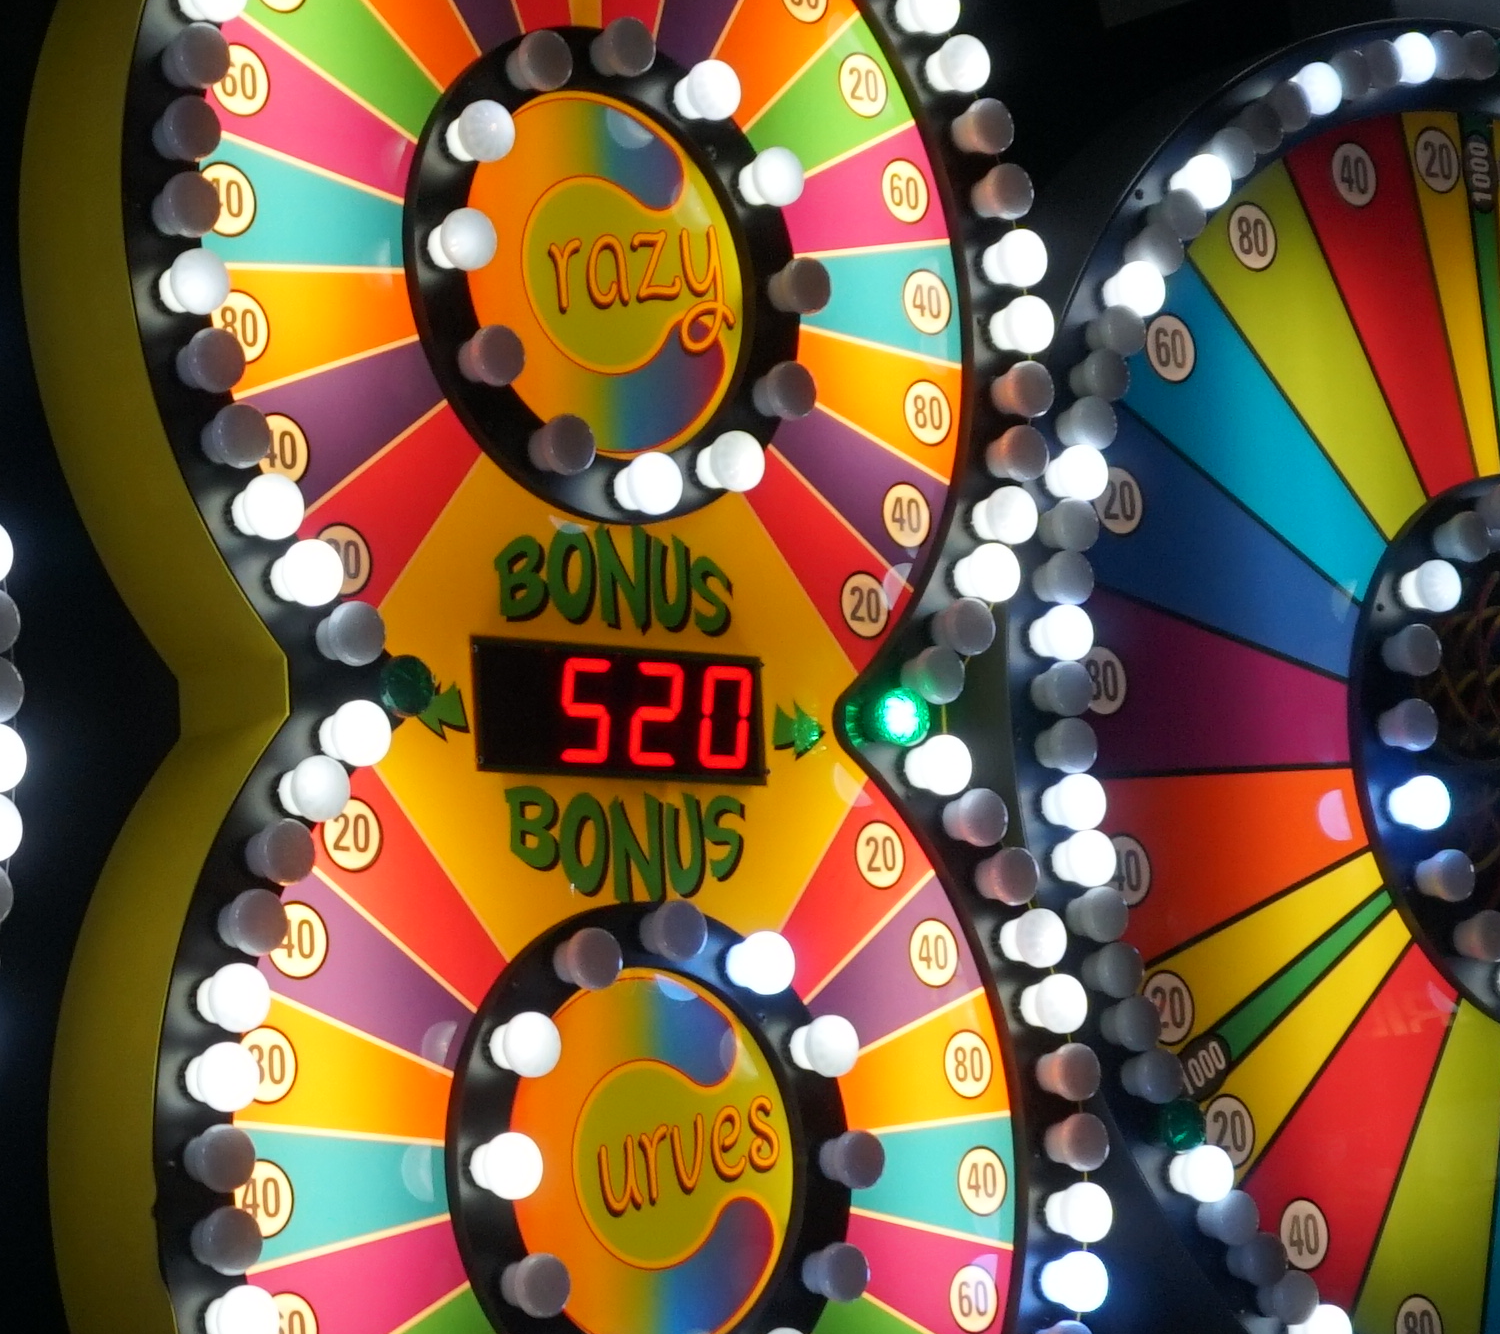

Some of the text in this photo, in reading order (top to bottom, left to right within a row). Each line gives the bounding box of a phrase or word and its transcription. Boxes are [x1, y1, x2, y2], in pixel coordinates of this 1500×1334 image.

[220, 62, 257, 100] 60
[849, 67, 878, 103] 20
[1341, 155, 1367, 192] 40
[1424, 141, 1452, 178] 20
[1470, 141, 1490, 203] 1000
[890, 174, 919, 211] 60
[1237, 217, 1267, 255] 80
[912, 287, 942, 321] 40
[220, 306, 258, 348] 80
[1155, 329, 1186, 367] 60
[913, 395, 943, 430] 80
[891, 497, 920, 533] 40
[1104, 481, 1135, 519] 20
[495, 525, 733, 636] BONUS
[850, 587, 881, 623] 20
[561, 657, 753, 769] 520
[334, 815, 370, 852] 20
[504, 785, 745, 903] BONUS
[865, 837, 896, 872] 20
[918, 935, 947, 969] 40
[953, 1047, 984, 1081] 80
[1214, 1112, 1246, 1151] 20
[967, 1163, 996, 1198] 40
[1288, 1216, 1320, 1255] 40
[957, 1281, 989, 1317] 60
